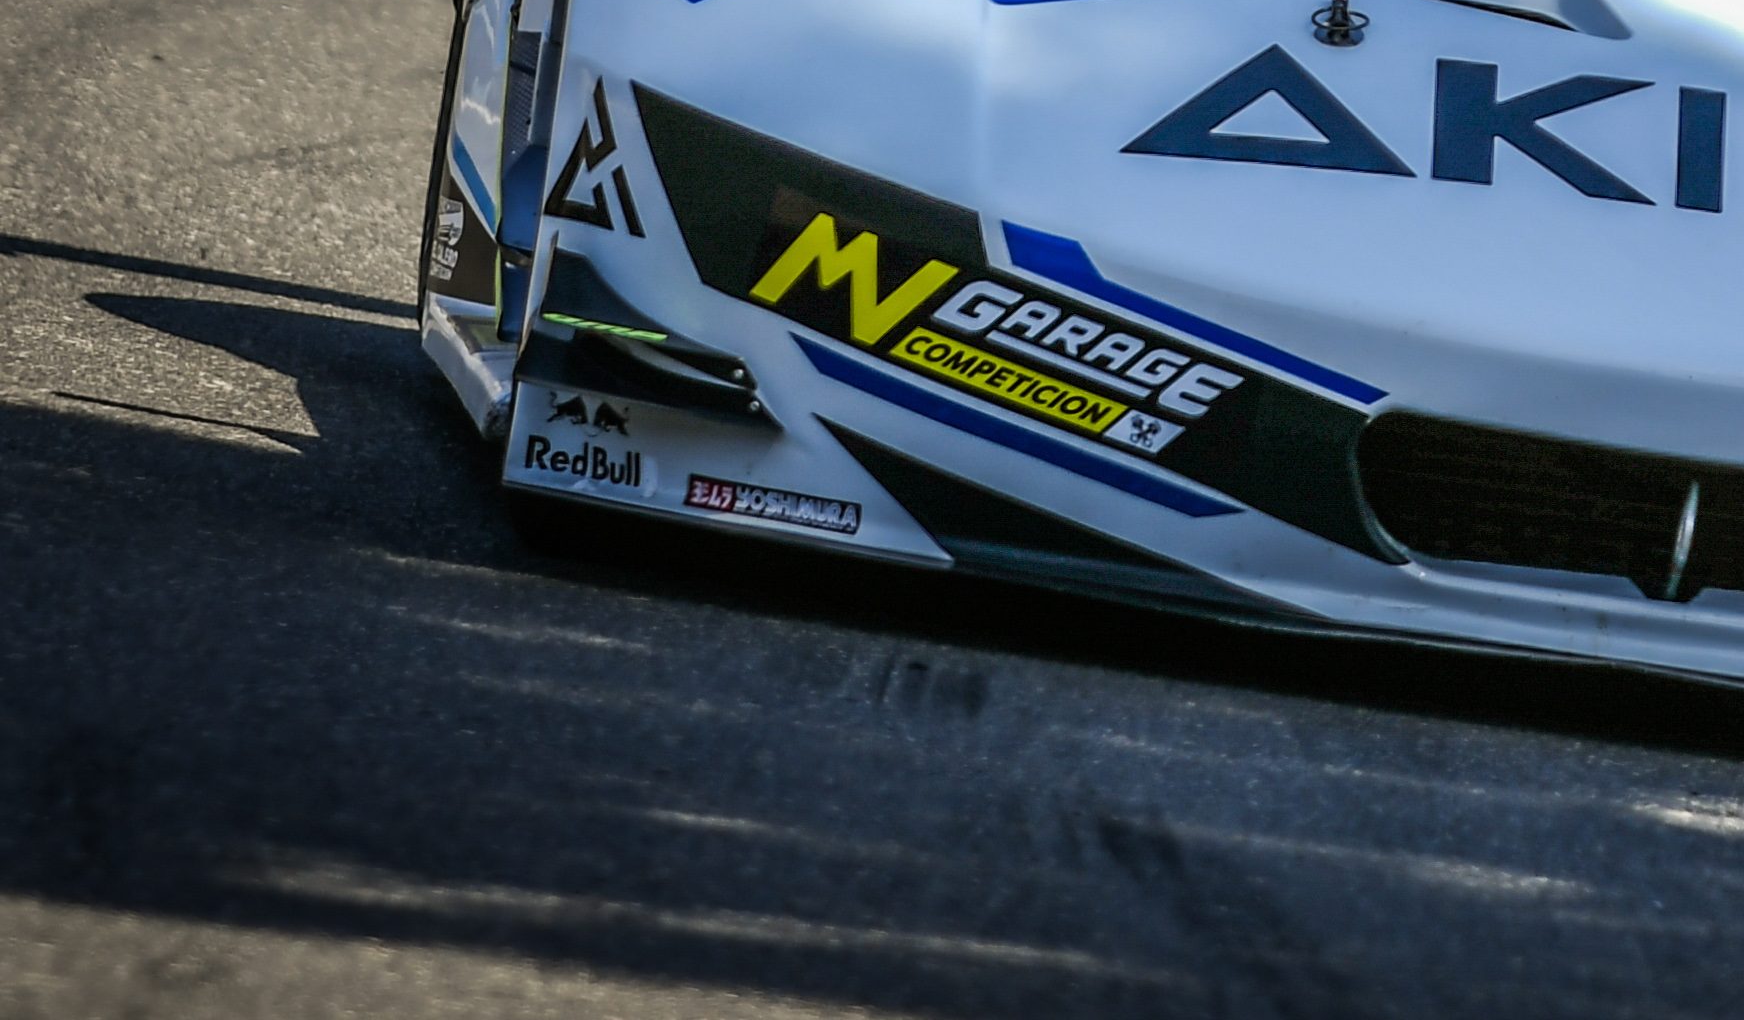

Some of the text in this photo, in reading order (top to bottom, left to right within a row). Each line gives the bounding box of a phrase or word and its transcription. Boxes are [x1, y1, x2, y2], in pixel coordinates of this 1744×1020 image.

[905, 334, 1110, 426] COMPETICION
[930, 279, 1245, 418] GARAGE
[733, 485, 858, 528] YOSHIMURA
